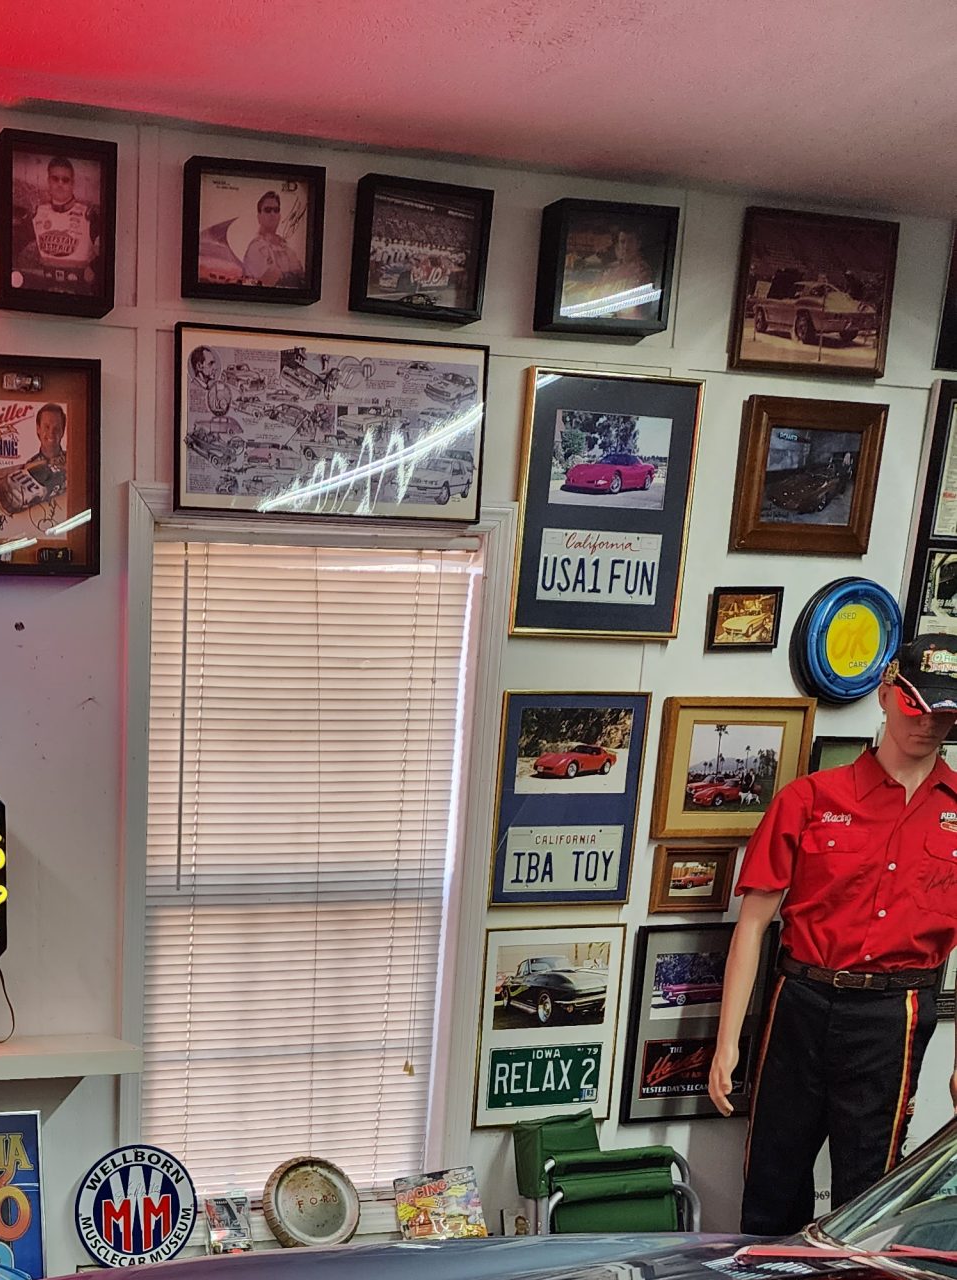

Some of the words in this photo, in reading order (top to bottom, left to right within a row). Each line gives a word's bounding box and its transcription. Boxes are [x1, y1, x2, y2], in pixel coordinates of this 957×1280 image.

[565, 532, 640, 555] California
[541, 556, 602, 594] USA1
[608, 559, 656, 596] FUN
[837, 612, 857, 620] USED
[831, 622, 873, 660] OK
[848, 660, 868, 669] CARS
[822, 811, 852, 826] Racing
[535, 834, 596, 845] CALIFORNIA
[511, 852, 554, 884] IBA
[572, 849, 615, 882] TOY
[532, 1048, 561, 1059] IOWA
[670, 1046, 683, 1054] THE
[493, 1059, 573, 1095] RELAX
[580, 1058, 596, 1090] 2
[642, 1083, 686, 1094] YESTERDAY'S
[85, 1150, 185, 1193] WELLBORN
[396, 1179, 449, 1204] RACING
[81, 1216, 146, 1267] MUSCLECAR
[149, 1207, 192, 1263] MUSEUM
